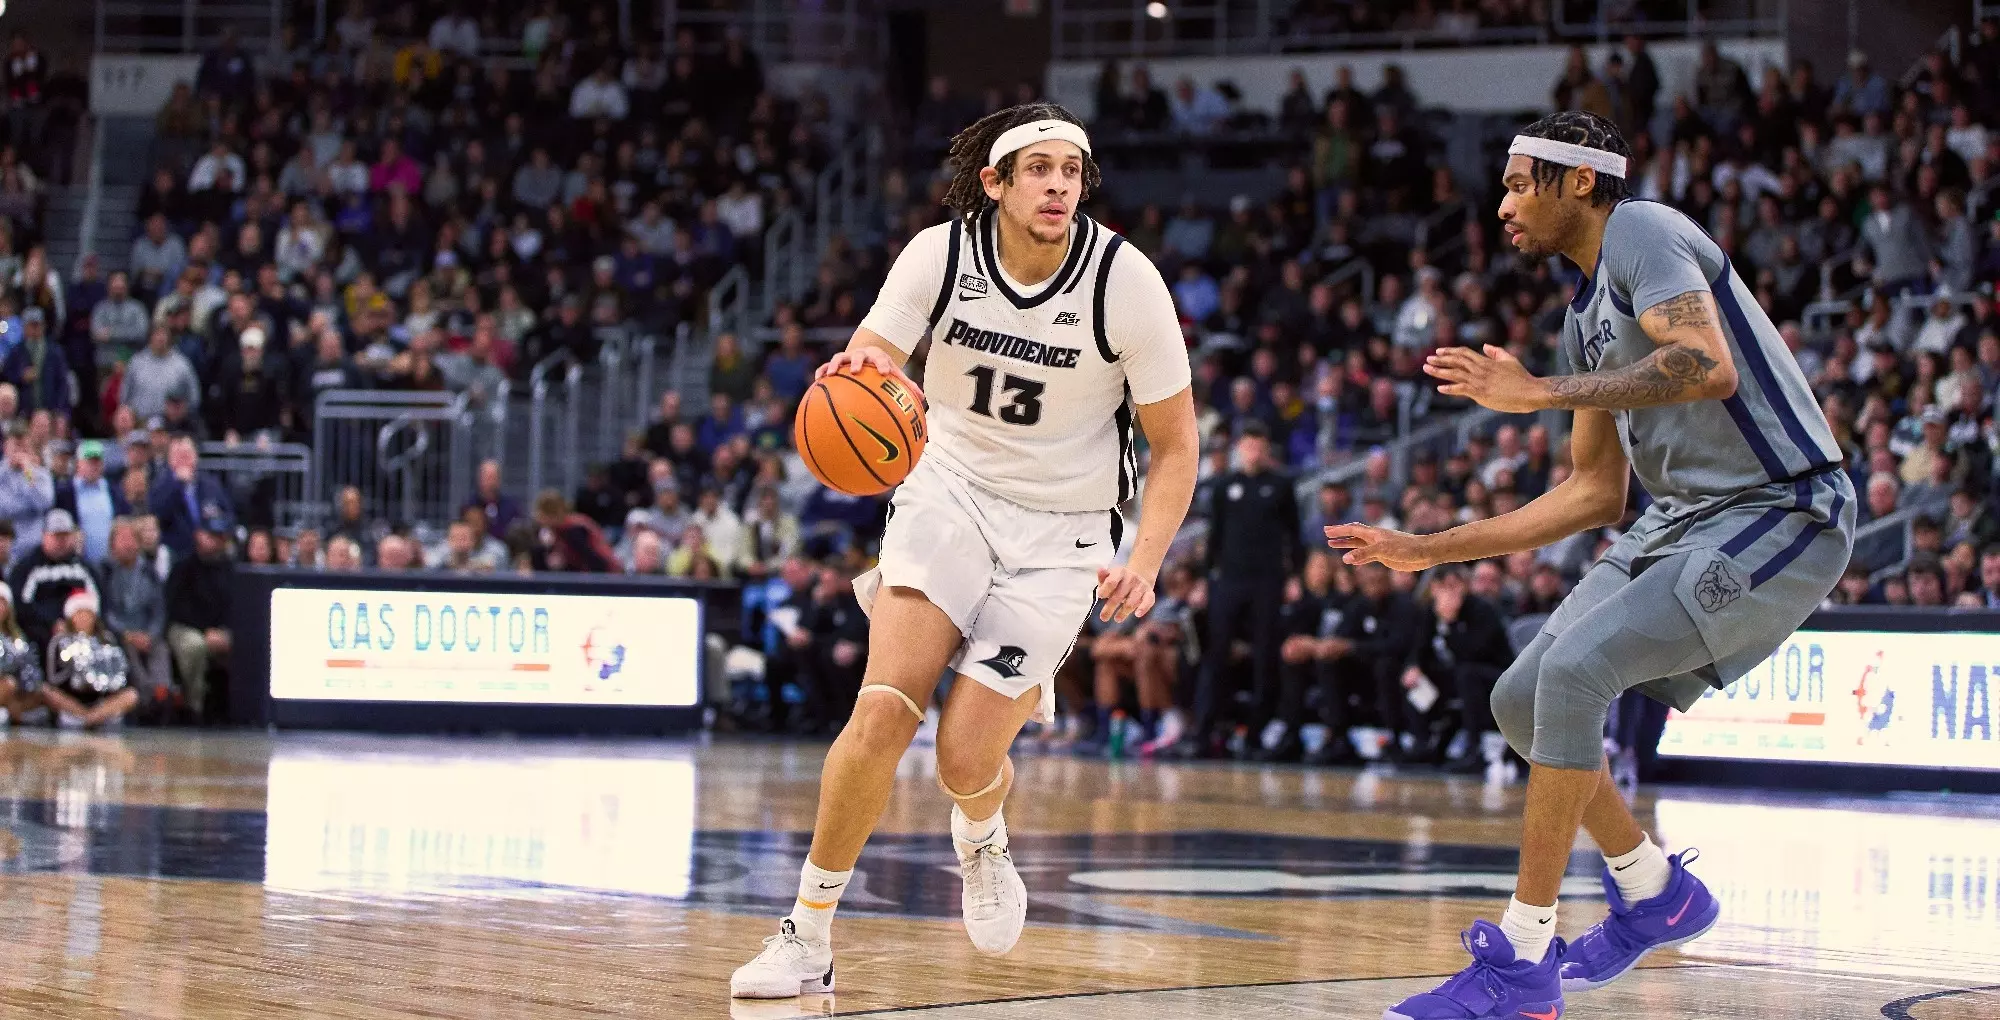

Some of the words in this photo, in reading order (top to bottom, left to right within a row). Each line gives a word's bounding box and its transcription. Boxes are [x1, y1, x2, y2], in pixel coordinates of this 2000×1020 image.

[1053, 317, 1081, 326] EAST
[1058, 311, 1077, 319] BIG
[943, 318, 1082, 369] PROVIDENCE
[880, 379, 924, 442] ELITE
[963, 364, 1047, 426] 13
[329, 602, 395, 649] GAS
[414, 604, 549, 652] DOCTOR
[1702, 643, 1825, 702] TOR
[1931, 664, 2000, 740] NA
